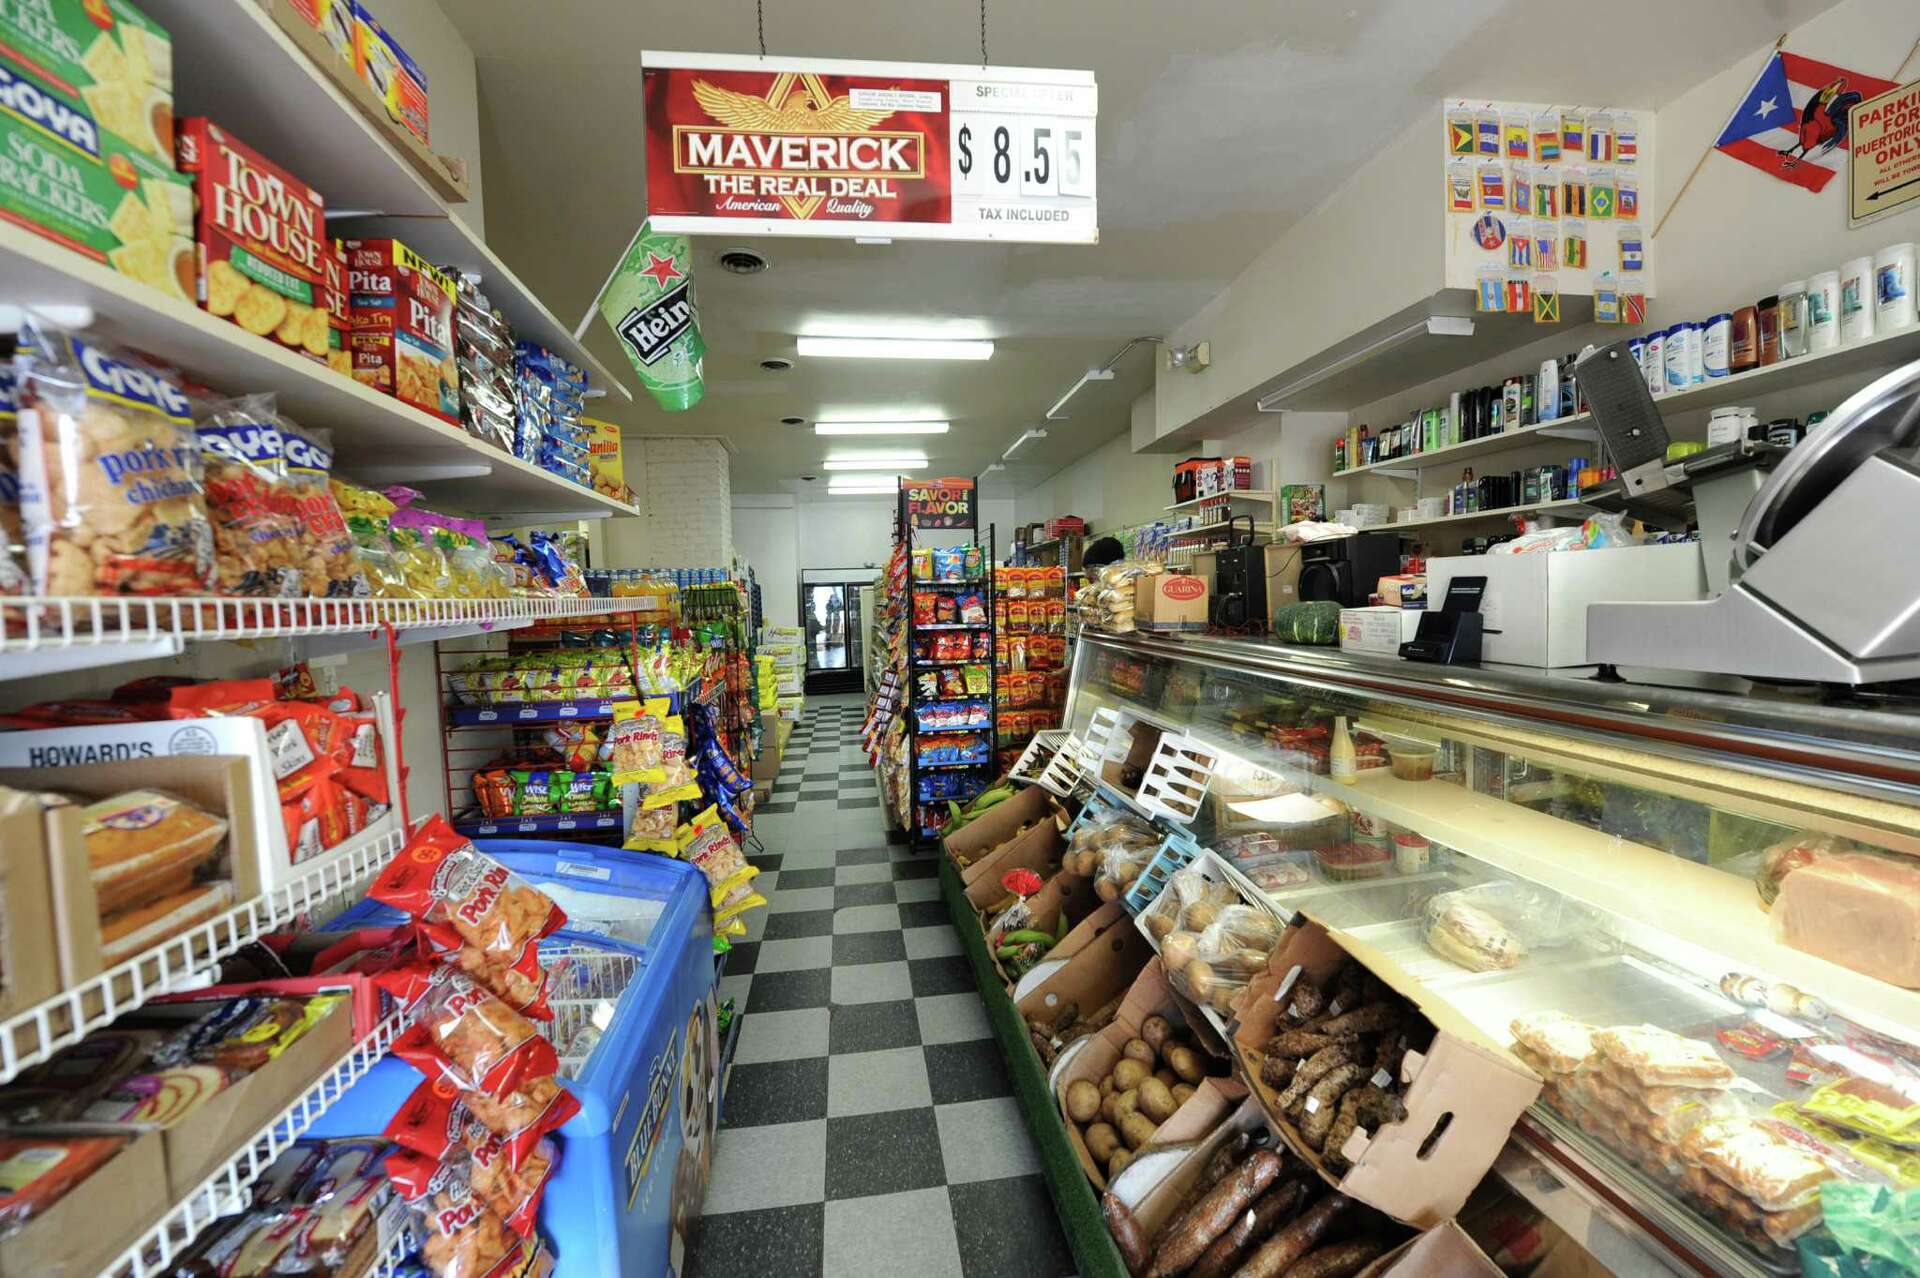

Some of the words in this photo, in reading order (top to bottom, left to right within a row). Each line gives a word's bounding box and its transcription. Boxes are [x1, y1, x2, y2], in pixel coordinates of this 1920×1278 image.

[1883, 108, 1920, 134] FOR
[8, 132, 86, 194] SODA
[687, 132, 911, 171] MAVERICK
[219, 145, 314, 237] TOWN
[704, 174, 755, 196] THE
[760, 176, 826, 198] REAL
[830, 177, 897, 199] DEAL
[715, 196, 783, 212] American
[826, 198, 874, 218] Quality
[979, 207, 1003, 220] TAX
[1006, 208, 1070, 222] INCLUDED
[213, 181, 323, 273] HOUSE
[350, 271, 393, 292] Pita
[410, 297, 449, 347] Pita
[358, 353, 383, 364] Pita
[909, 488, 961, 501] SAVOR
[908, 501, 969, 514] FLAVOR
[29, 741, 154, 769] HOWARD'S
